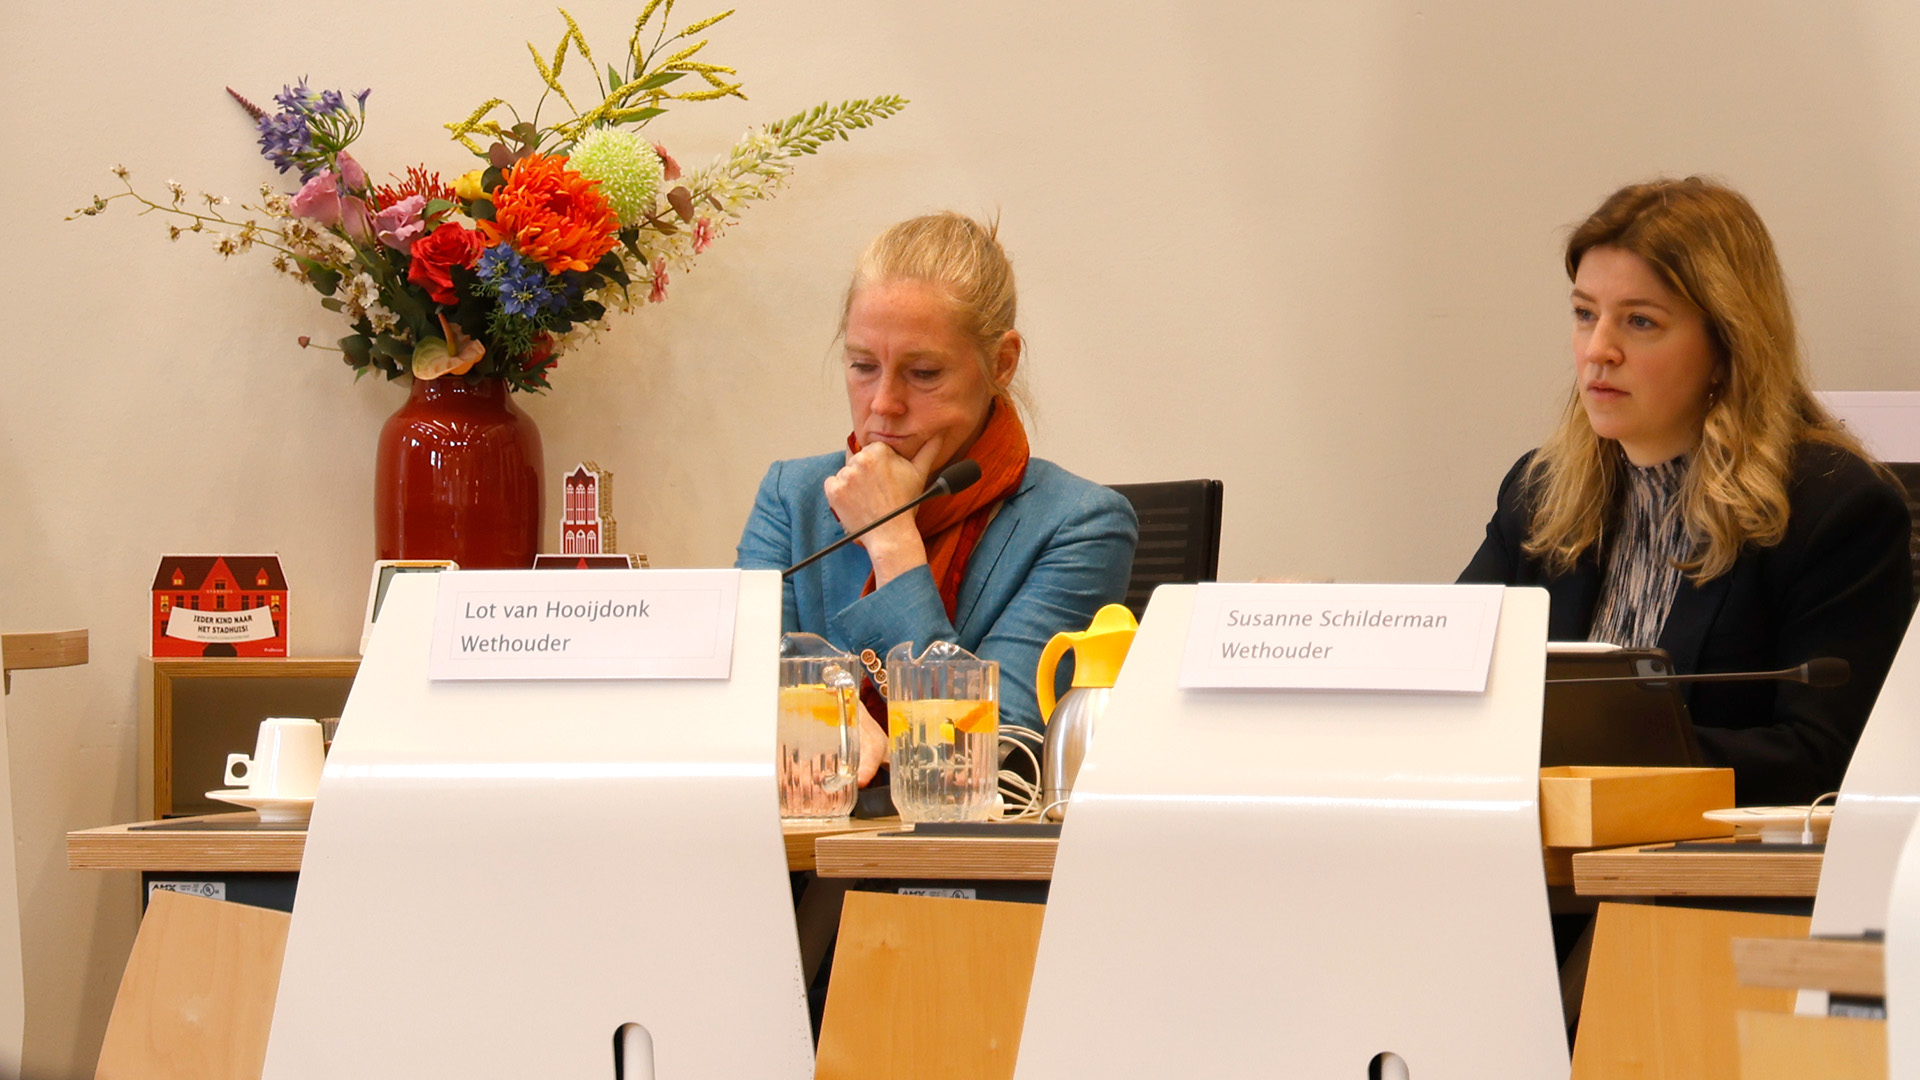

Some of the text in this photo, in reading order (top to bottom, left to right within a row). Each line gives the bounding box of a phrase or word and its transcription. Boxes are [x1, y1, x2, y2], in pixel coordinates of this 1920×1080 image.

[193, 615, 214, 624] IEDER
[234, 615, 253, 623] NAAR
[465, 600, 650, 622] Lot van Hooijdonk
[1227, 609, 1448, 628] Susanne Schilderman
[212, 625, 248, 634] STADHUIS!
[461, 633, 572, 653] Wethouder
[1222, 641, 1333, 659] Wethouder
